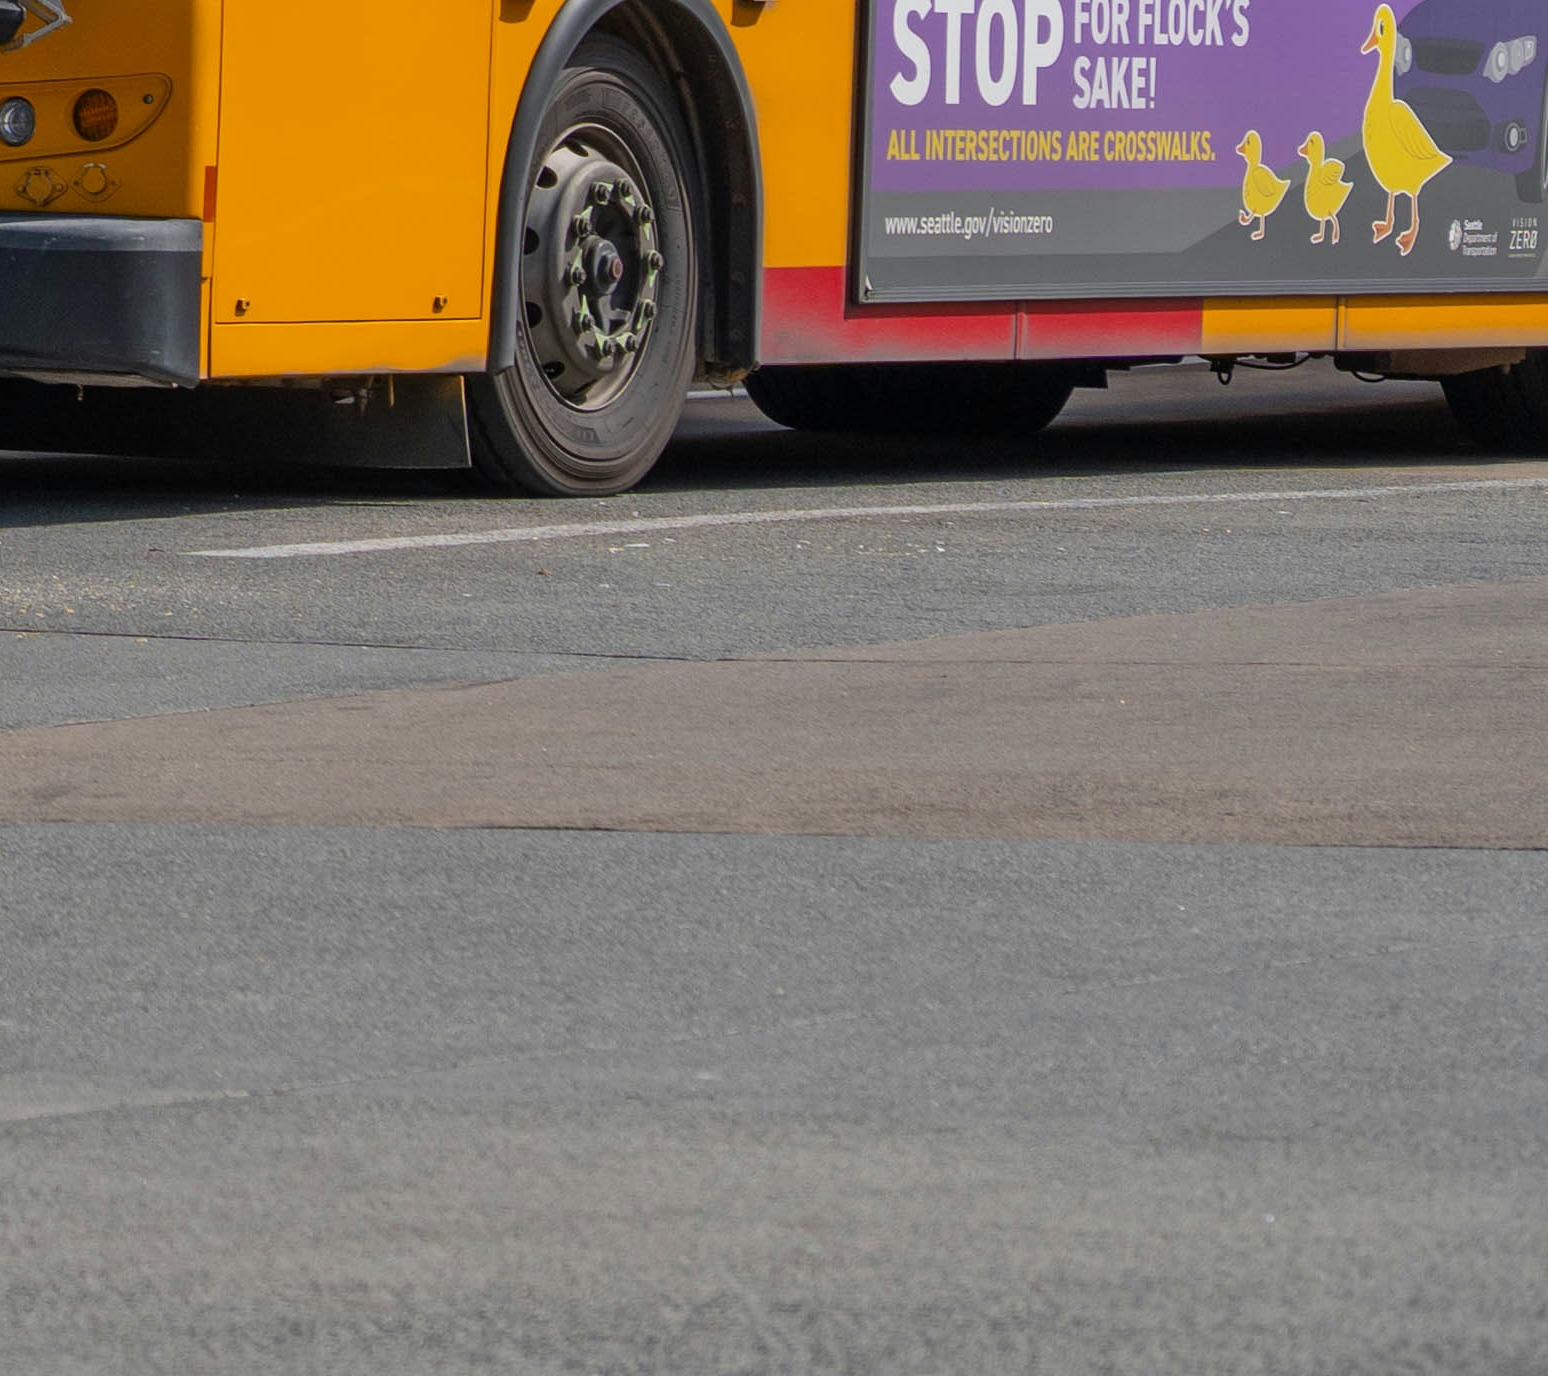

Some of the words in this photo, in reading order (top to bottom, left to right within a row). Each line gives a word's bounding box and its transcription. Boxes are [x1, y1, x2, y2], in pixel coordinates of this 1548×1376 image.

[1072, 55, 1157, 110] SAKE!
[886, 128, 920, 161] ALL
[925, 129, 1062, 162] INTERSECTIONS
[1066, 130, 1100, 161] ARE
[1104, 131, 1216, 162] CROSSWALKS.
[885, 208, 1054, 240] www.seattle.gov/visionzero
